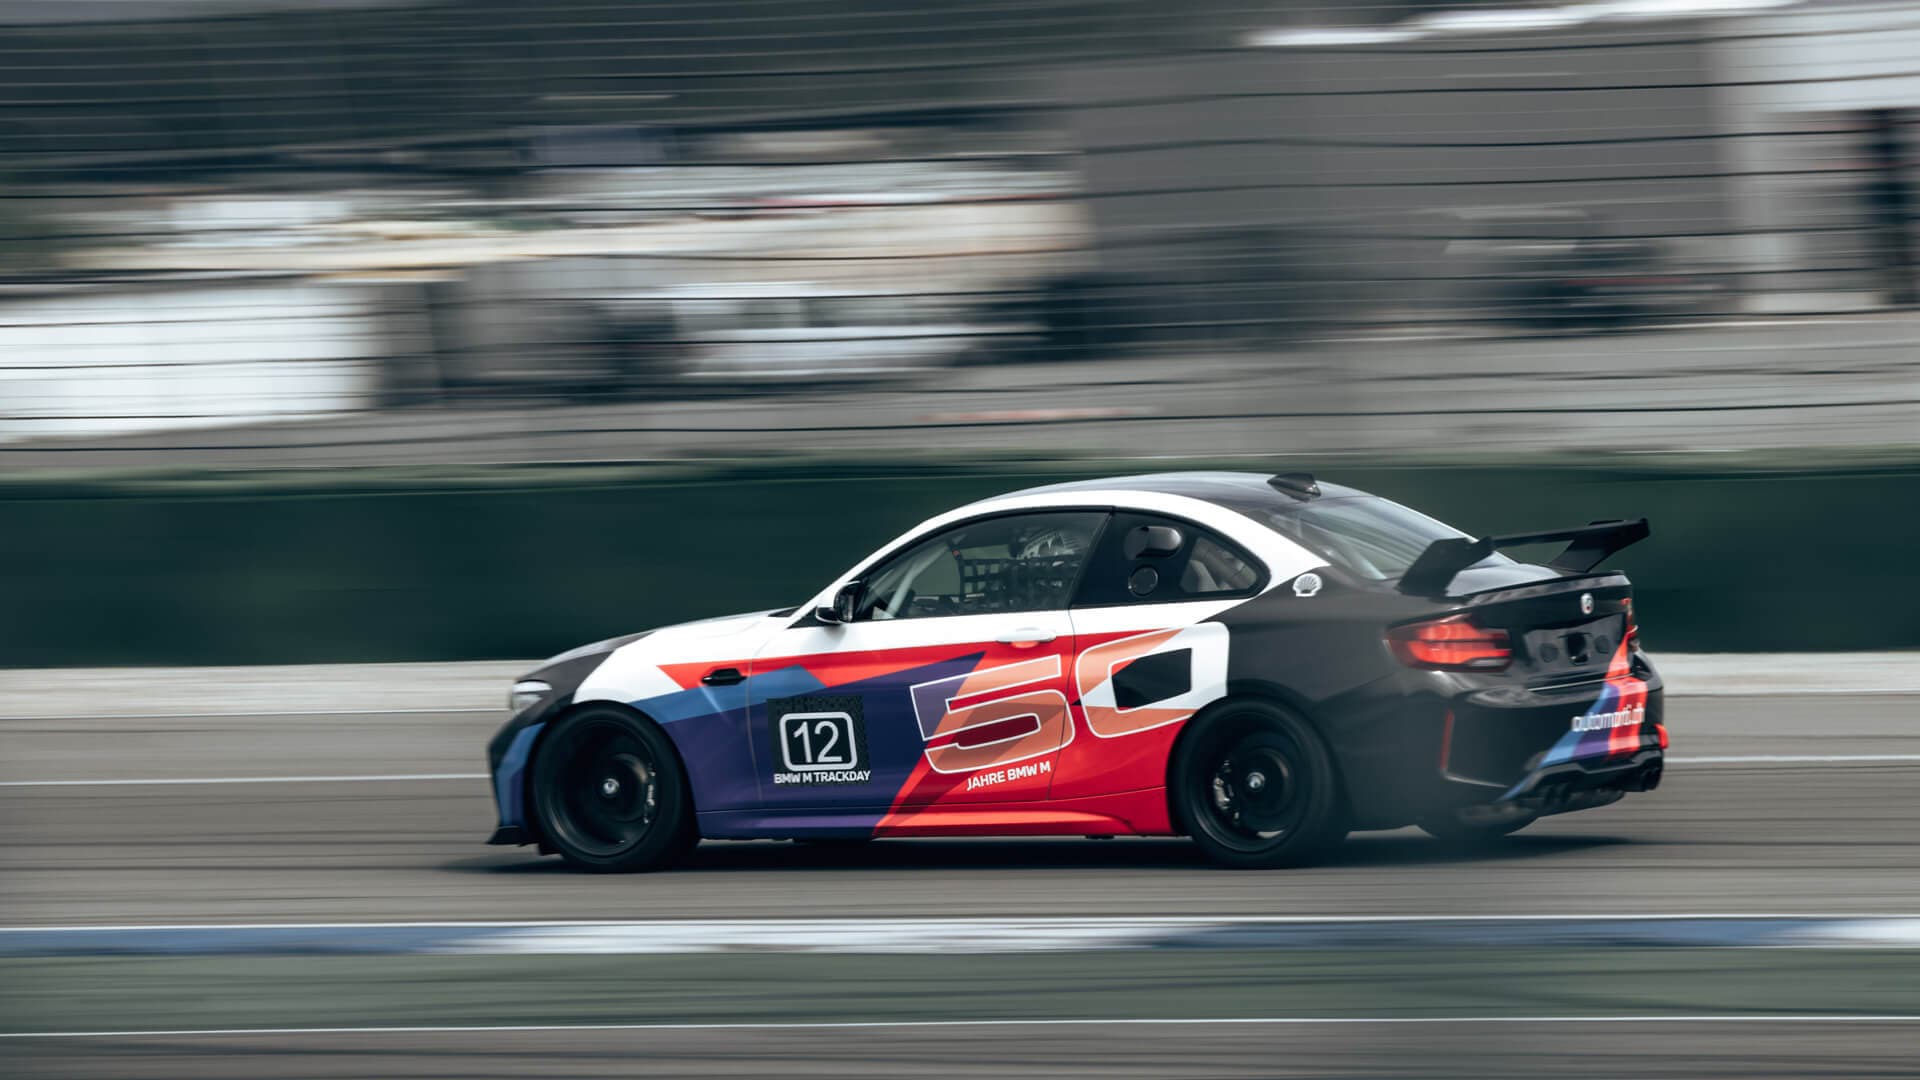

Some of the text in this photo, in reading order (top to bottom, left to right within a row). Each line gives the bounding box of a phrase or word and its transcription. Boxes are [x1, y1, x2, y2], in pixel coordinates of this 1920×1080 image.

[909, 621, 1230, 774] 50
[793, 720, 842, 763] 12
[773, 770, 871, 784] BMW M TRACKDAY
[966, 760, 1051, 791] JAHRE BMW M
